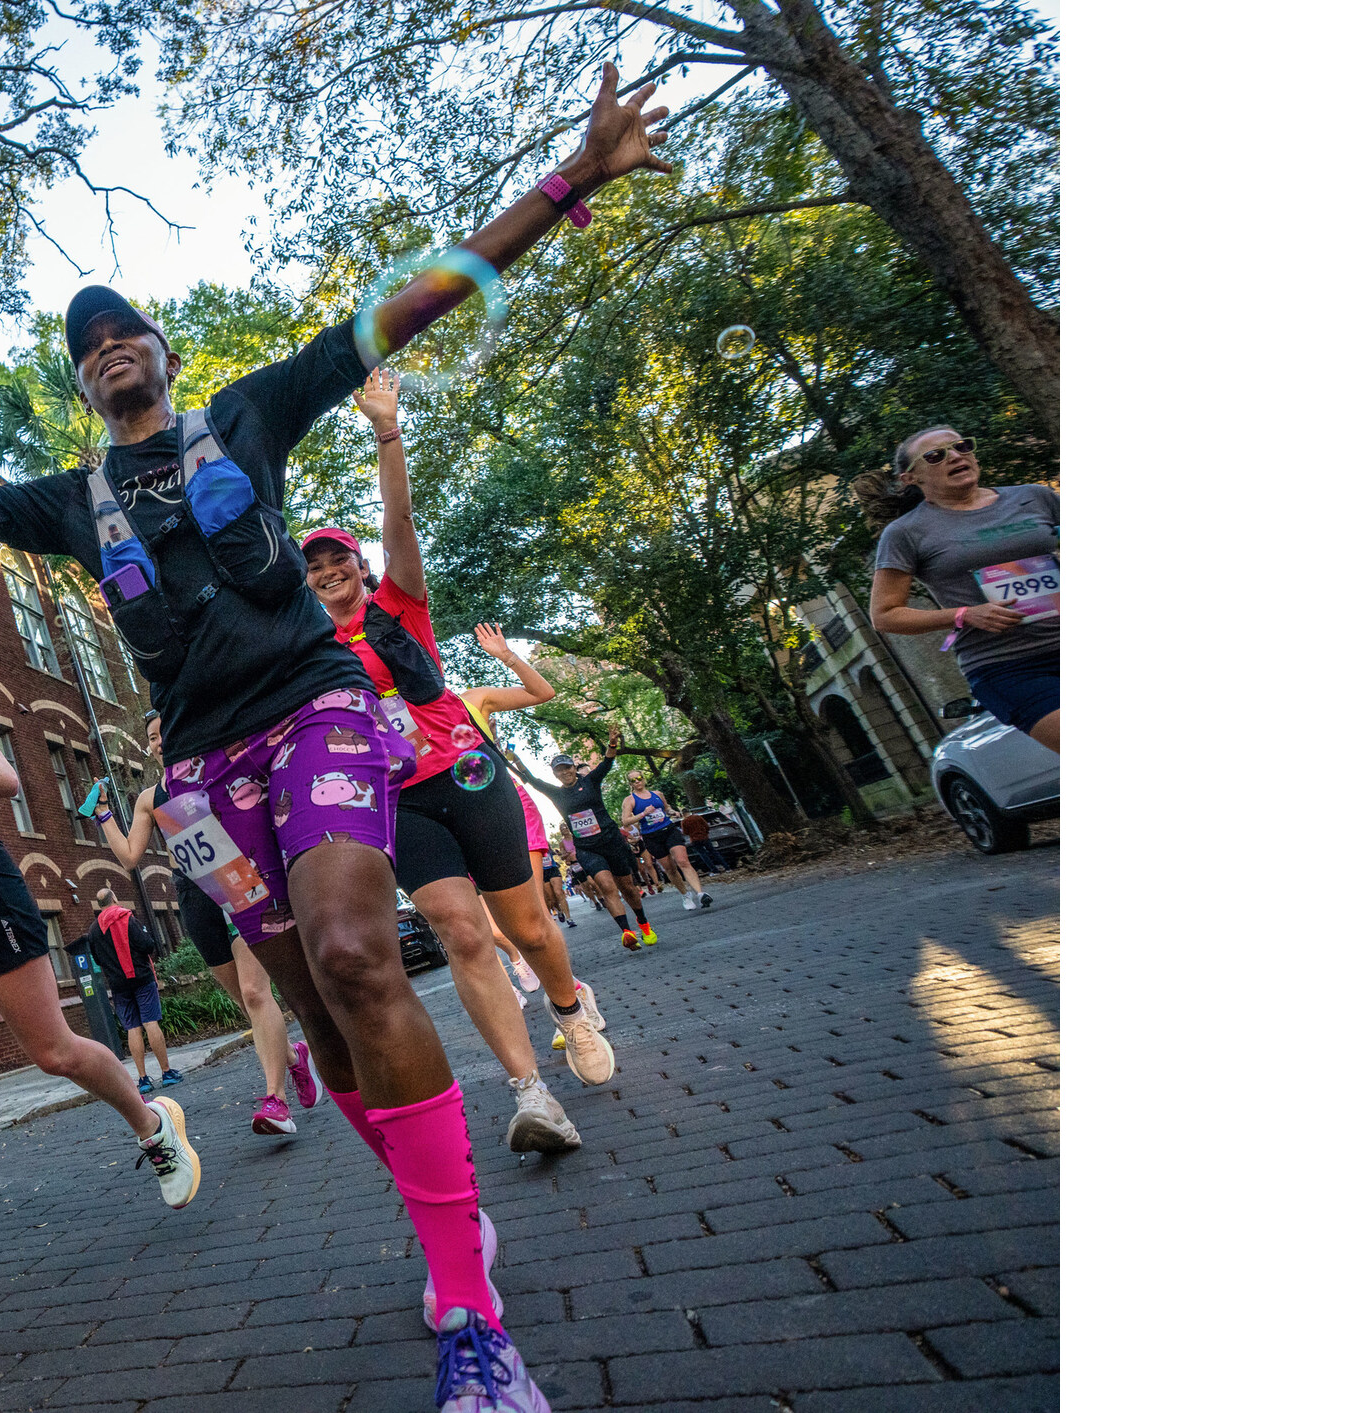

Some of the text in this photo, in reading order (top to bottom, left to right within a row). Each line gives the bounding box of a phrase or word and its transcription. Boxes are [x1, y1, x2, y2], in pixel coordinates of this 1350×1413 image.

[996, 574, 1059, 600] 7898
[573, 817, 593, 829] 7962
[4, 926, 22, 953] TERREX
[77, 955, 86, 968] P
